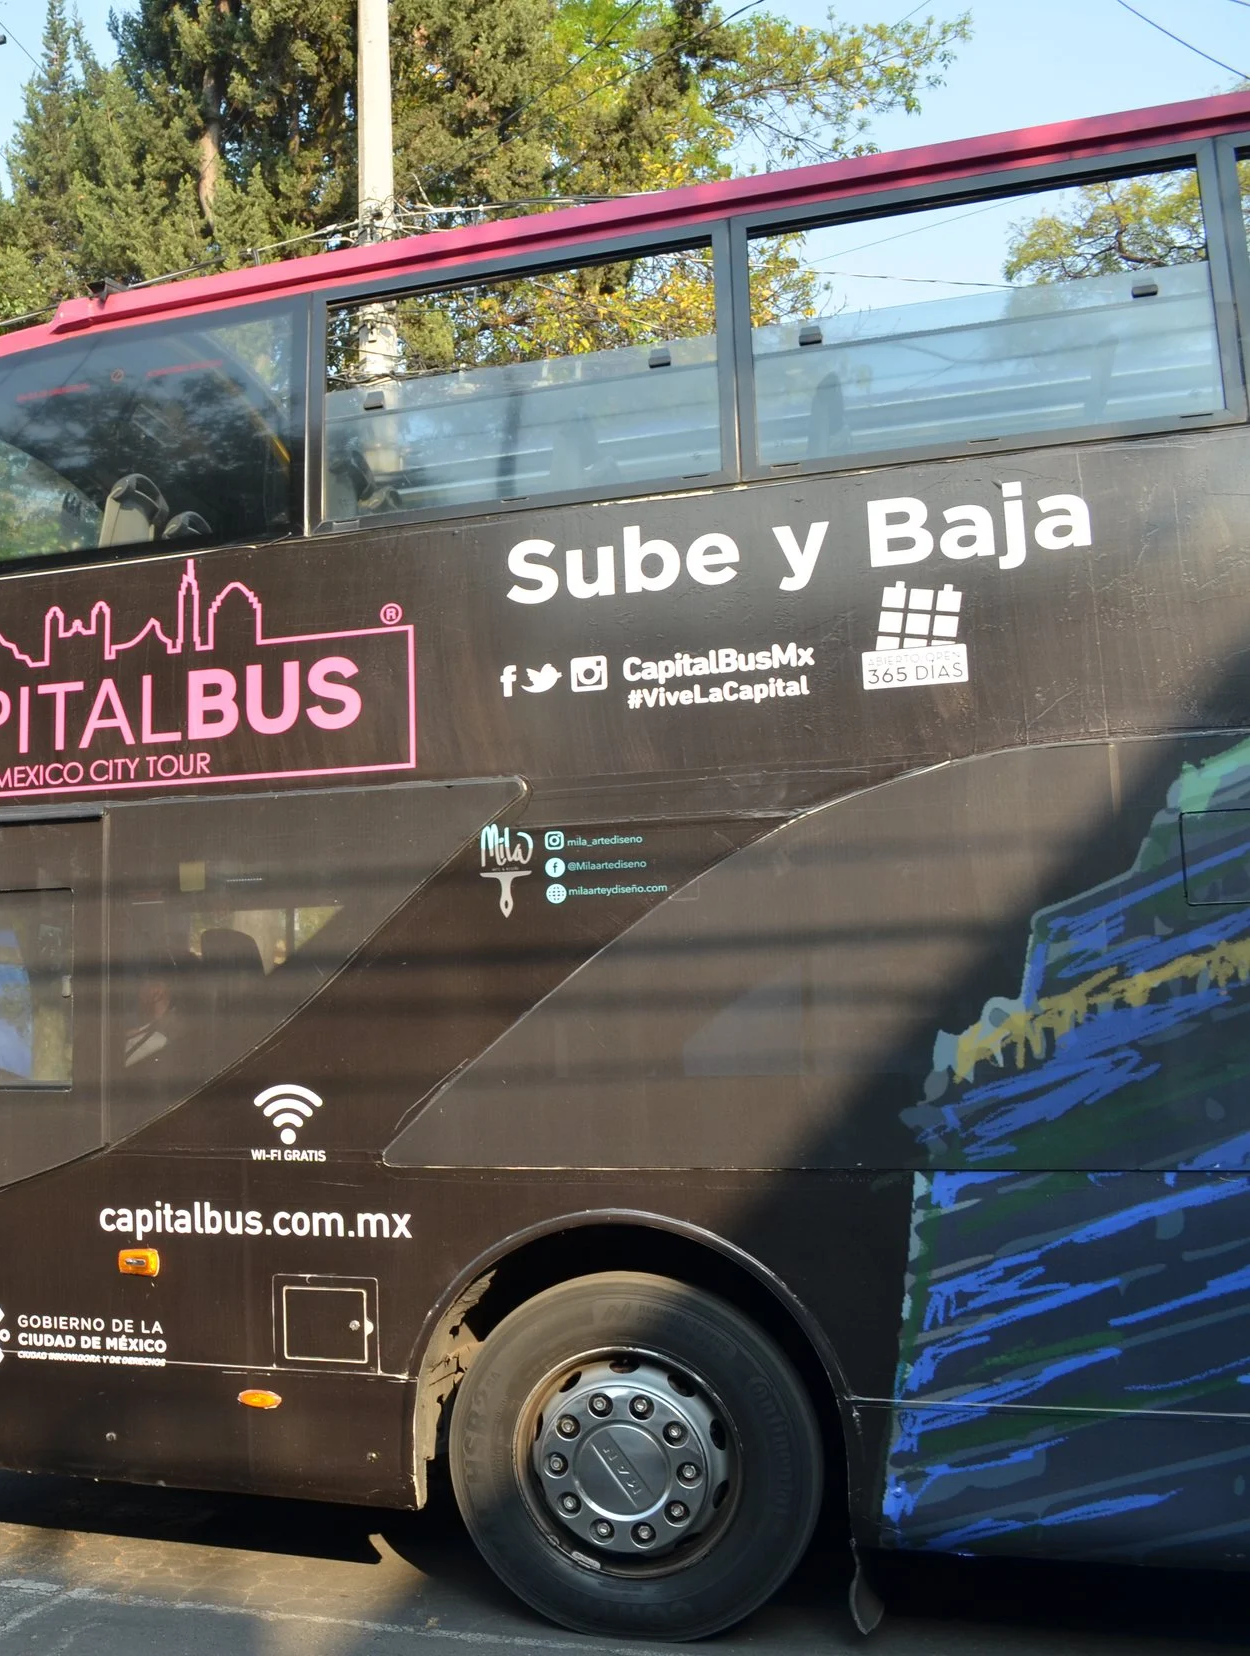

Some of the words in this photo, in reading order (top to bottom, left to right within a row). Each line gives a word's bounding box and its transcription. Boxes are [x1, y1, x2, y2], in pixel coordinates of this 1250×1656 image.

[506, 525, 740, 604] Sube
[772, 520, 829, 591] y
[867, 481, 1092, 570] Baja
[622, 642, 815, 684] CapitalBusMx
[868, 667, 908, 684] 365
[915, 660, 963, 681] DÍAS
[627, 675, 810, 709] #ViveLaCapital
[89, 757, 139, 782] CITY
[145, 752, 211, 778] TOUR
[567, 835, 643, 847] mila_artediseno
[567, 859, 647, 871] @Milaartediseno
[250, 1149, 282, 1161] WI-FI
[283, 1149, 327, 1162] GRATIS
[99, 1201, 413, 1240] capitalbus.com.mx
[17, 1314, 105, 1332] GOBIERNO
[111, 1319, 134, 1333] DE
[141, 1320, 163, 1334] LA
[17, 1332, 76, 1348] CIUDAD
[80, 1335, 101, 1349] DE
[105, 1335, 167, 1353] MÉXICO
